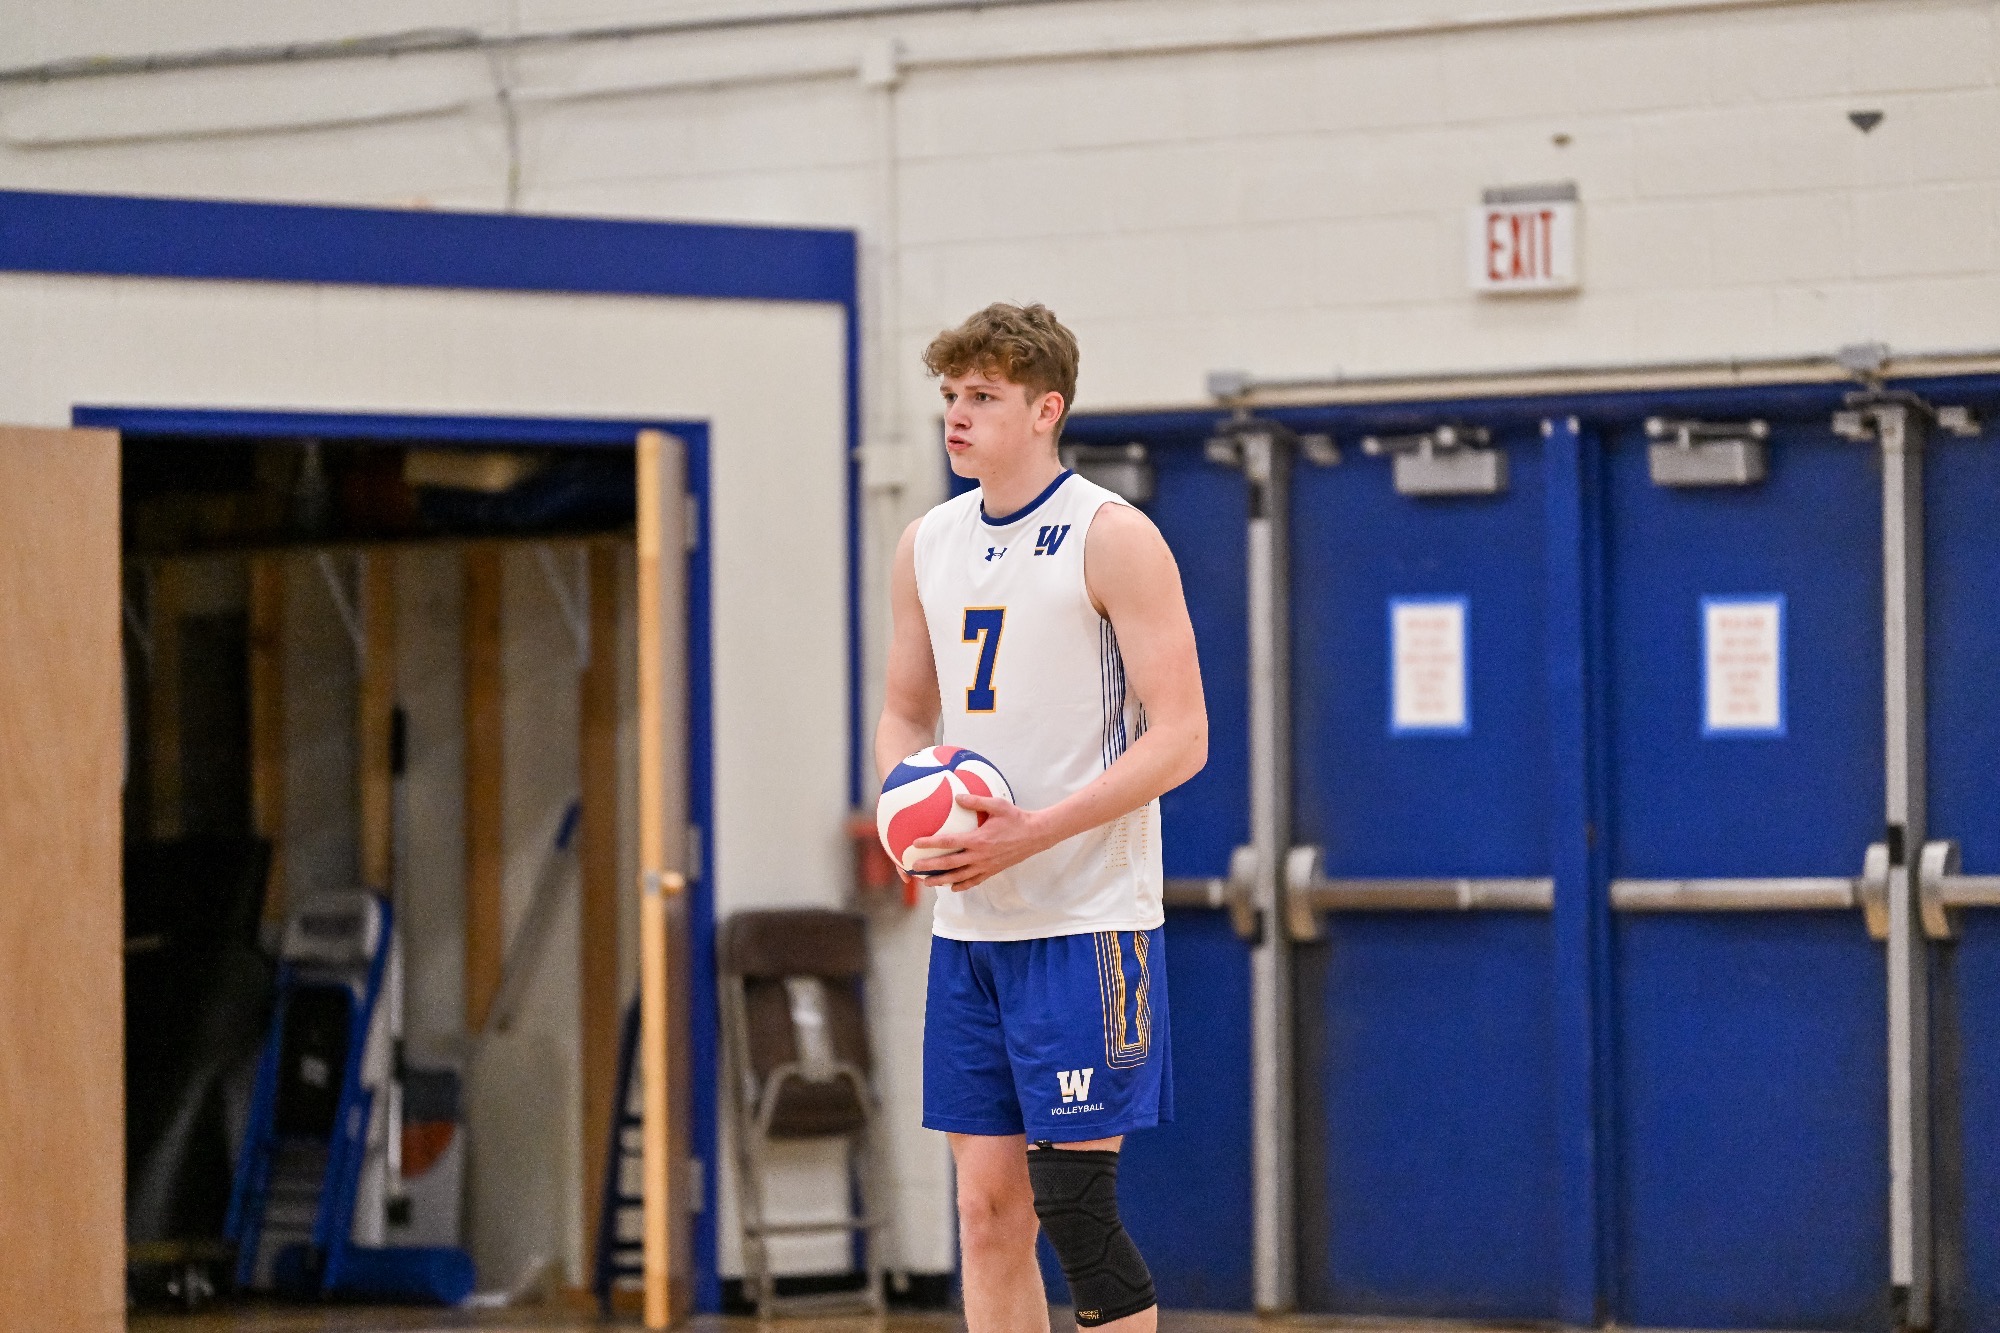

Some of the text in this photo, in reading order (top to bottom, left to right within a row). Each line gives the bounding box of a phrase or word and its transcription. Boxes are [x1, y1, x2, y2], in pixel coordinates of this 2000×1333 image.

[1487, 210, 1554, 280] EXIT
[1034, 524, 1071, 556] W
[961, 606, 1007, 713] 7
[1057, 1068, 1093, 1103] W
[1051, 1103, 1104, 1115] VOLLEYBALL
